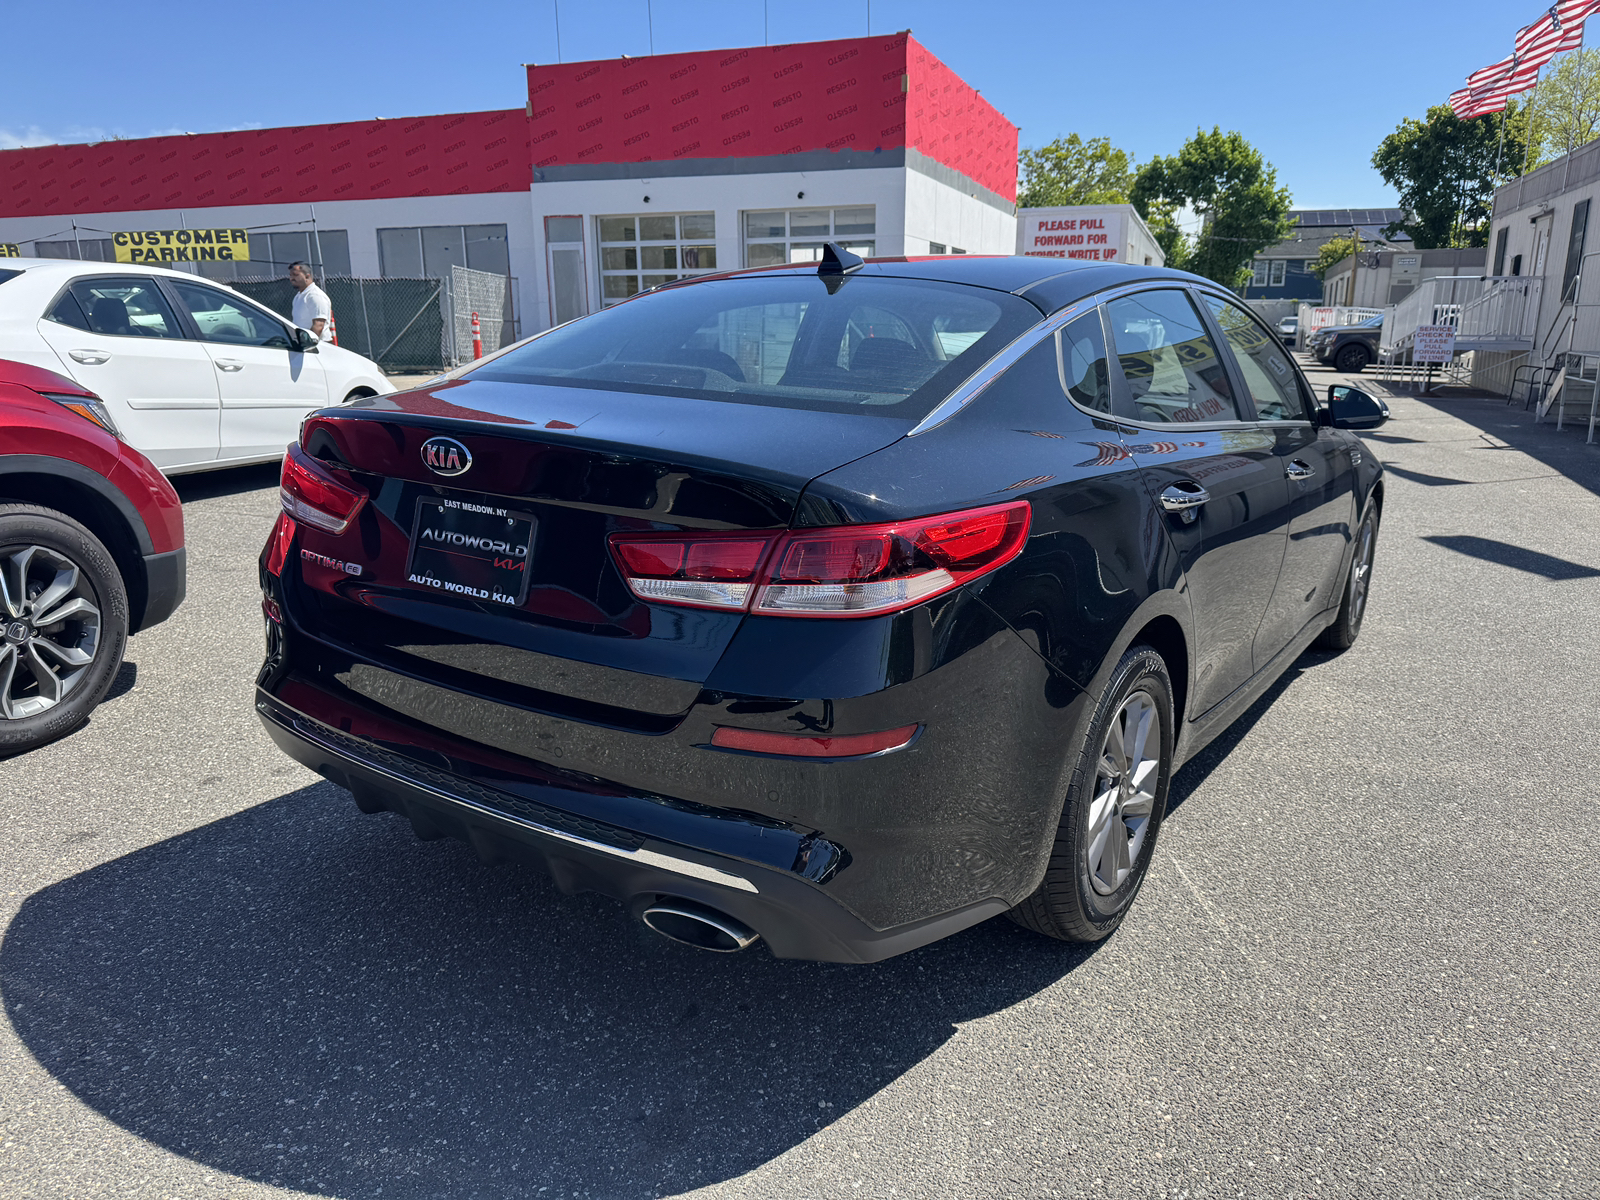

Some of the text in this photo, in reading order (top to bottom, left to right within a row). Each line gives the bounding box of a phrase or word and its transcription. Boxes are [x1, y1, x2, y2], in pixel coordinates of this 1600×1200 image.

[719, 50, 749, 68] RESISTO
[827, 49, 858, 66] RESISTO
[574, 65, 601, 82] RESISTO
[669, 64, 697, 80] RESISTO
[773, 62, 803, 79] RESISTO
[882, 66, 907, 82] RESIST
[530, 79, 555, 95] RESISTO
[621, 80, 648, 95] RESISTO
[721, 76, 750, 93] RESISTO
[825, 78, 856, 95] RESISTO
[575, 93, 601, 108] RESISTO
[671, 90, 699, 106] RESISTO
[772, 91, 802, 108] RESISTO
[483, 113, 507, 127] RESISTO
[623, 104, 650, 120] RESISTO
[721, 105, 750, 121] RESISTO
[827, 104, 858, 121] RESISTO
[365, 122, 386, 135] RESISTO
[405, 120, 427, 134] RESISTO
[442, 116, 465, 130] RESISTO
[577, 117, 602, 132] RESISTO
[671, 117, 698, 132] RESISTO
[773, 117, 803, 133] RESISTO
[881, 122, 906, 138] RESIST
[483, 137, 506, 150] RESISTO
[532, 130, 558, 144] RESISTO
[623, 131, 650, 146] RESISTO
[722, 130, 750, 146] RESISTO
[825, 133, 856, 149] RESISTO
[367, 145, 388, 158] RESISTO
[405, 144, 426, 156] RESISTO
[443, 141, 466, 153] RESISTO
[577, 144, 603, 158] RESISTO
[673, 141, 700, 157] RESISTO
[407, 165, 428, 177] RESISTO
[446, 162, 468, 175] RESISTO
[486, 159, 508, 172] RESISTO
[370, 179, 390, 190] RESISTO
[1038, 219, 1105, 231] PLEASE PULL
[114, 229, 247, 246] CUSTOMER
[1034, 234, 1108, 246] FORWARD FOR
[130, 246, 233, 261] PARKING
[1068, 249, 1100, 260] WRITE
[1103, 248, 1118, 260] UP
[426, 444, 462, 470] KIA
[444, 500, 460, 510] EAST
[496, 508, 508, 517] NY
[421, 528, 528, 558] AUTOWORLD
[300, 548, 344, 572] OPTIMA
[408, 574, 516, 605] AUTO WORLD KIA
